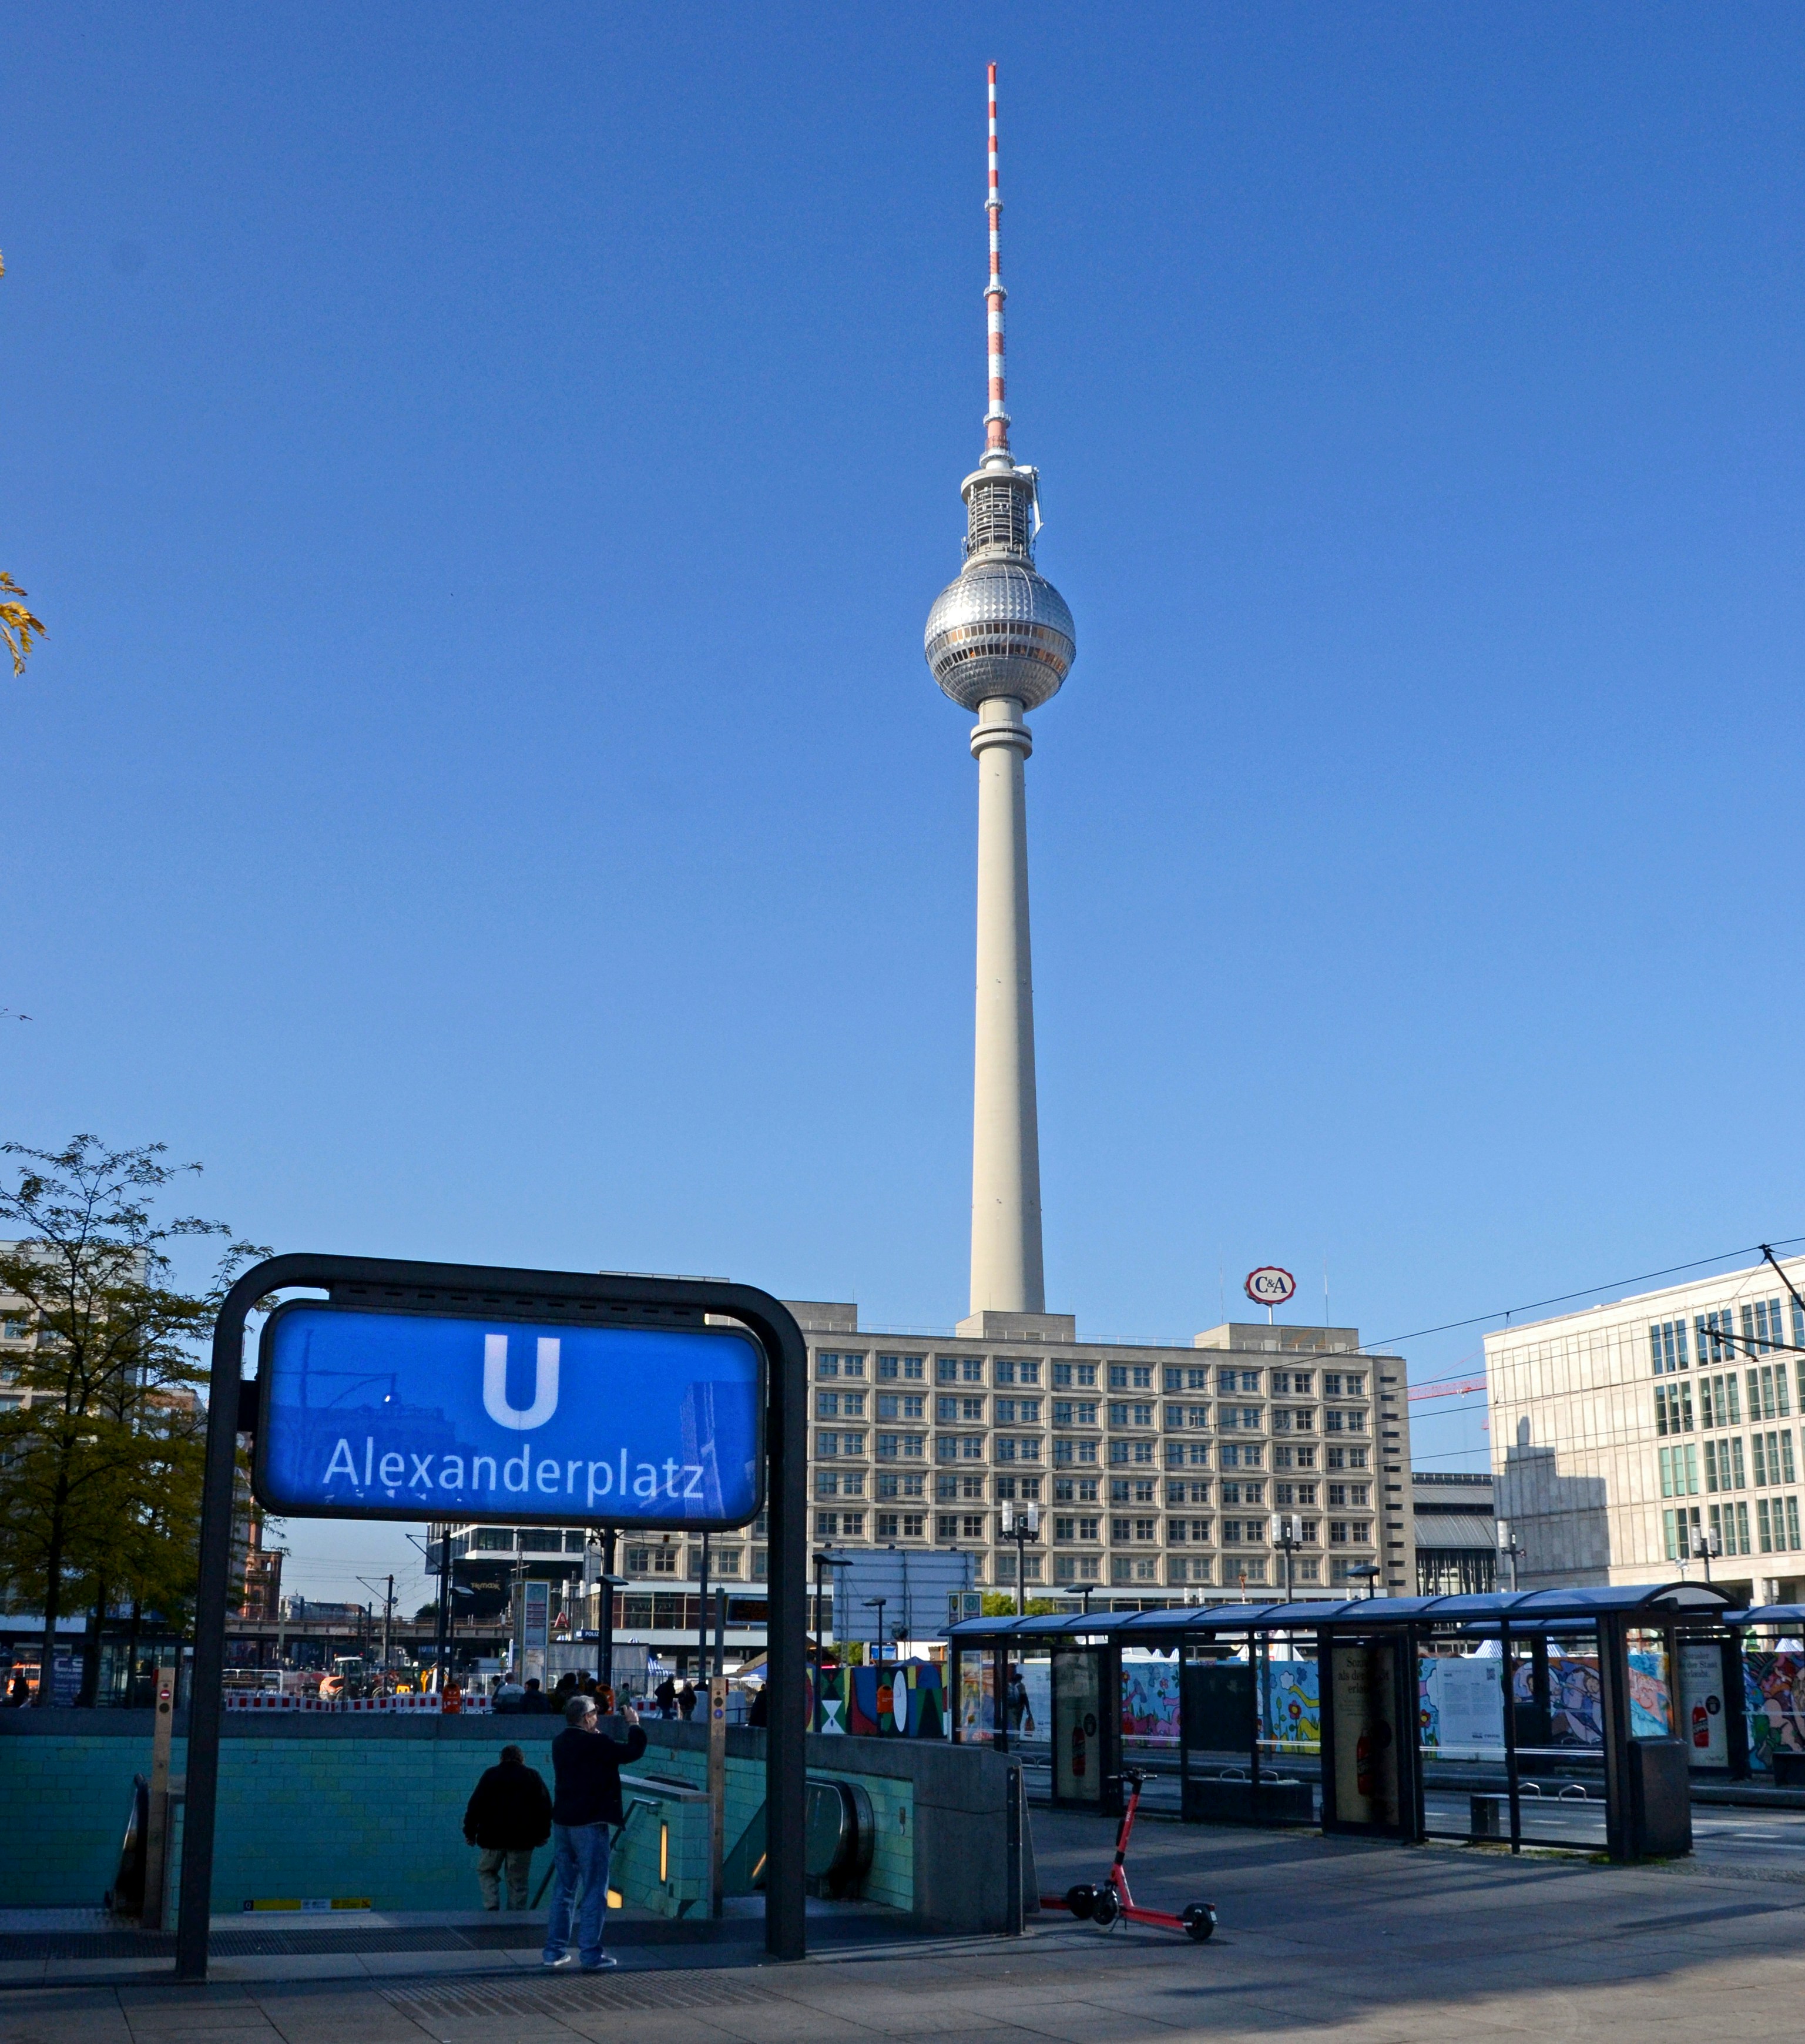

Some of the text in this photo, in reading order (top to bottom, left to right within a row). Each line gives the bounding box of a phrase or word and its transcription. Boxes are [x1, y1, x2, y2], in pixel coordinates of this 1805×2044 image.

[1256, 1276, 1287, 1293] C&A
[483, 1334, 561, 1430] U
[323, 1436, 704, 1508] Alexanderplatz
